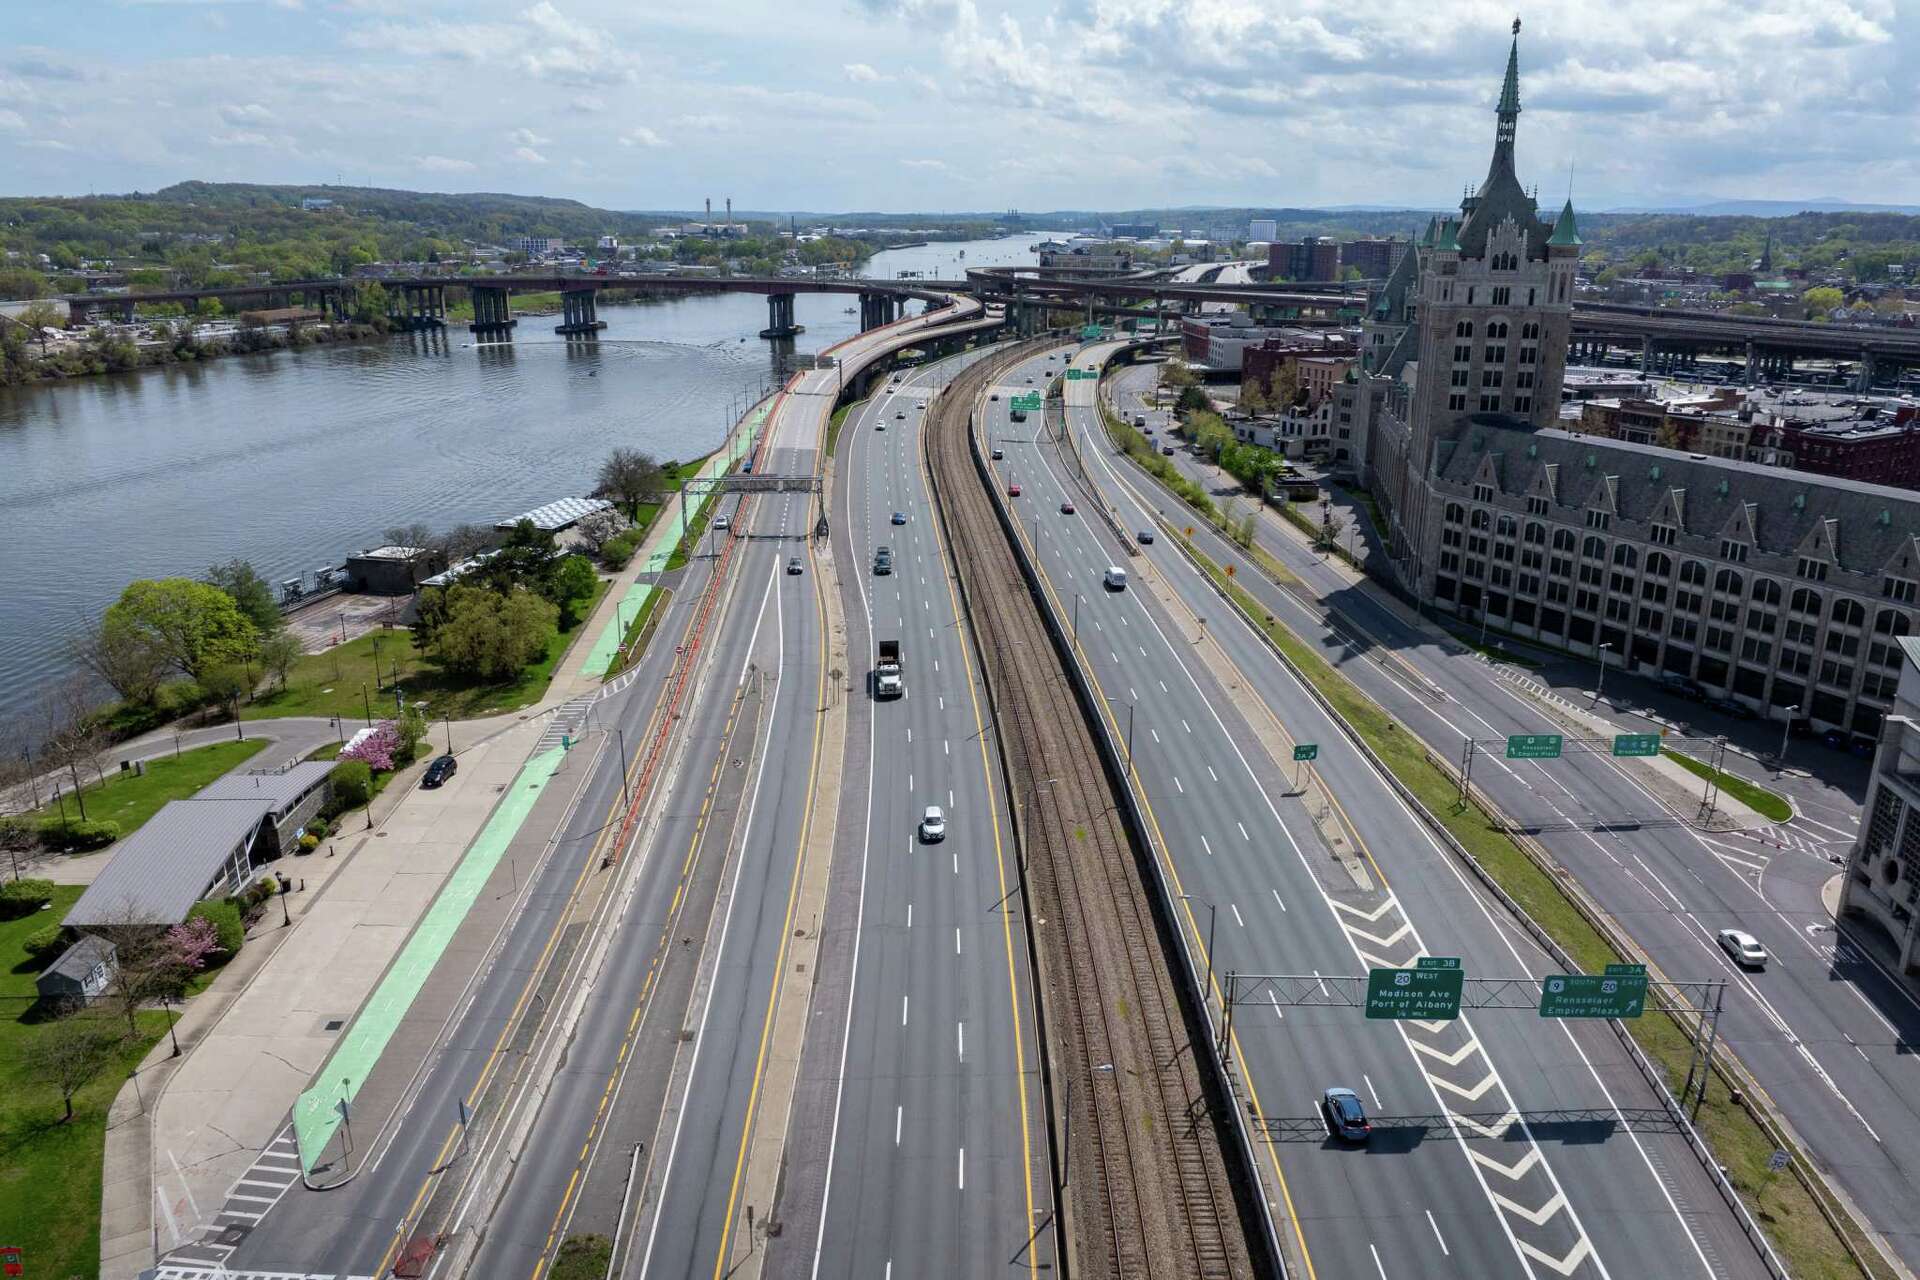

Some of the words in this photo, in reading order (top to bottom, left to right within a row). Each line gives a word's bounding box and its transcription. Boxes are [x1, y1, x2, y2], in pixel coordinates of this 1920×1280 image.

[1396, 975, 1410, 984] 20
[1552, 982, 1560, 991] 9
[1602, 982, 1616, 991] 20
[1379, 990, 1423, 998] Madison
[1429, 990, 1450, 998] Ave
[1371, 1000, 1395, 1008] Port
[1399, 1000, 1410, 1008] of
[1415, 1001, 1453, 1010] Albany
[1547, 1006, 1585, 1015] Empire
[1590, 1007, 1620, 1015] Plaza
